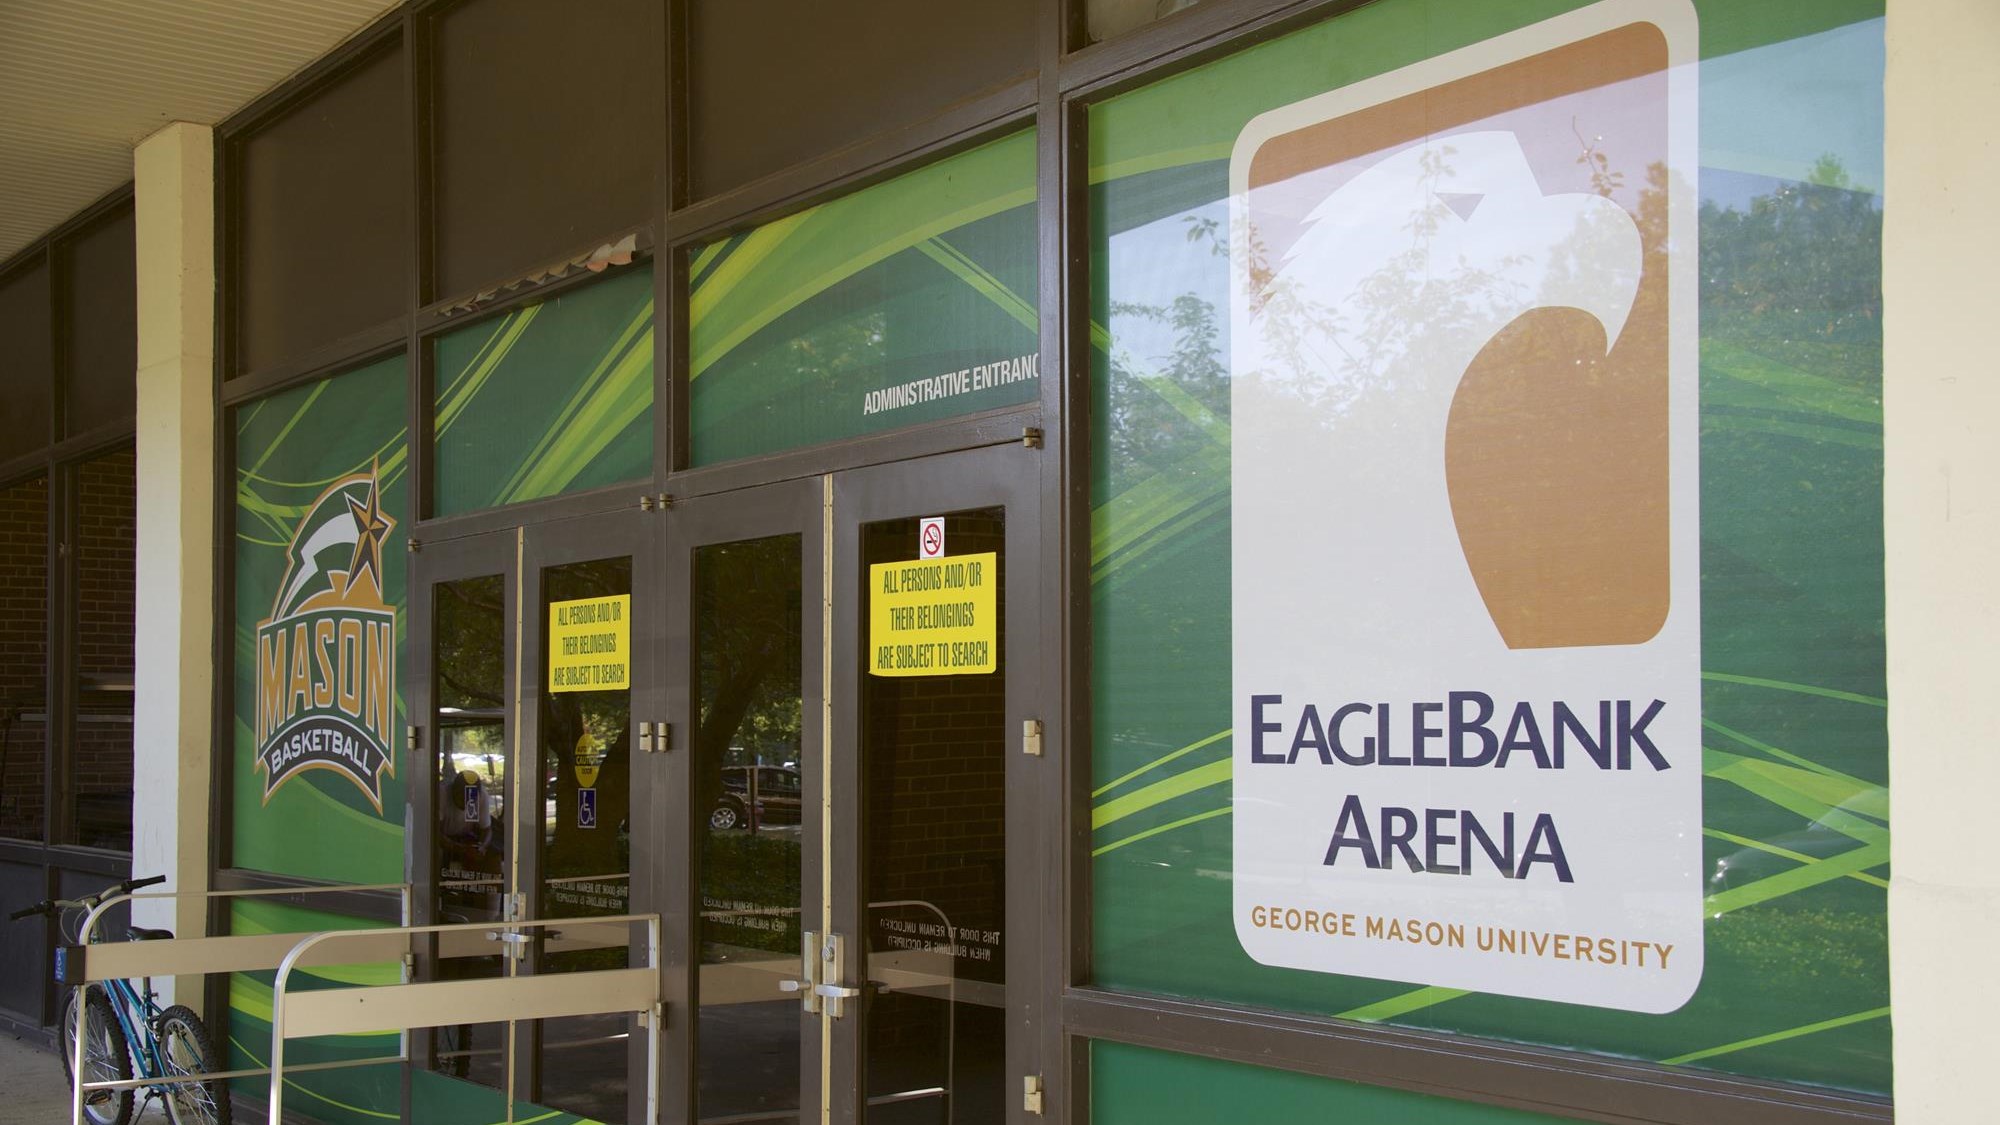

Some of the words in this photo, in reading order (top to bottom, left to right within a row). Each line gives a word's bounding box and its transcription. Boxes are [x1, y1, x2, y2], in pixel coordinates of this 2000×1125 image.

[864, 369, 970, 415] ADMINISTRATIVE
[884, 570, 898, 593] ALL
[901, 565, 941, 592] PERSONS
[944, 561, 982, 590] AND/OR
[558, 607, 568, 626] ALL
[570, 604, 596, 625] PERSONS
[597, 601, 622, 623] AND/OR
[890, 606, 915, 631] THEIR
[918, 602, 974, 629] BELONGINGS
[562, 636, 578, 656] THEIR
[580, 633, 616, 654] BELONGINGS
[877, 646, 893, 669] ARE
[896, 643, 935, 668] SUBJECT
[938, 643, 949, 667] TO
[952, 641, 988, 666] SEARCH
[260, 618, 390, 750] MASON
[554, 667, 565, 686] ARE
[566, 665, 591, 685] SUBJECT
[592, 665, 600, 684] TO
[602, 664, 624, 684] SEARCH
[271, 728, 372, 776] BASKETBALL
[1251, 905, 1356, 937] GEORGE
[1366, 916, 1465, 948] MASON
[1477, 926, 1674, 969] UNIVERSITY
